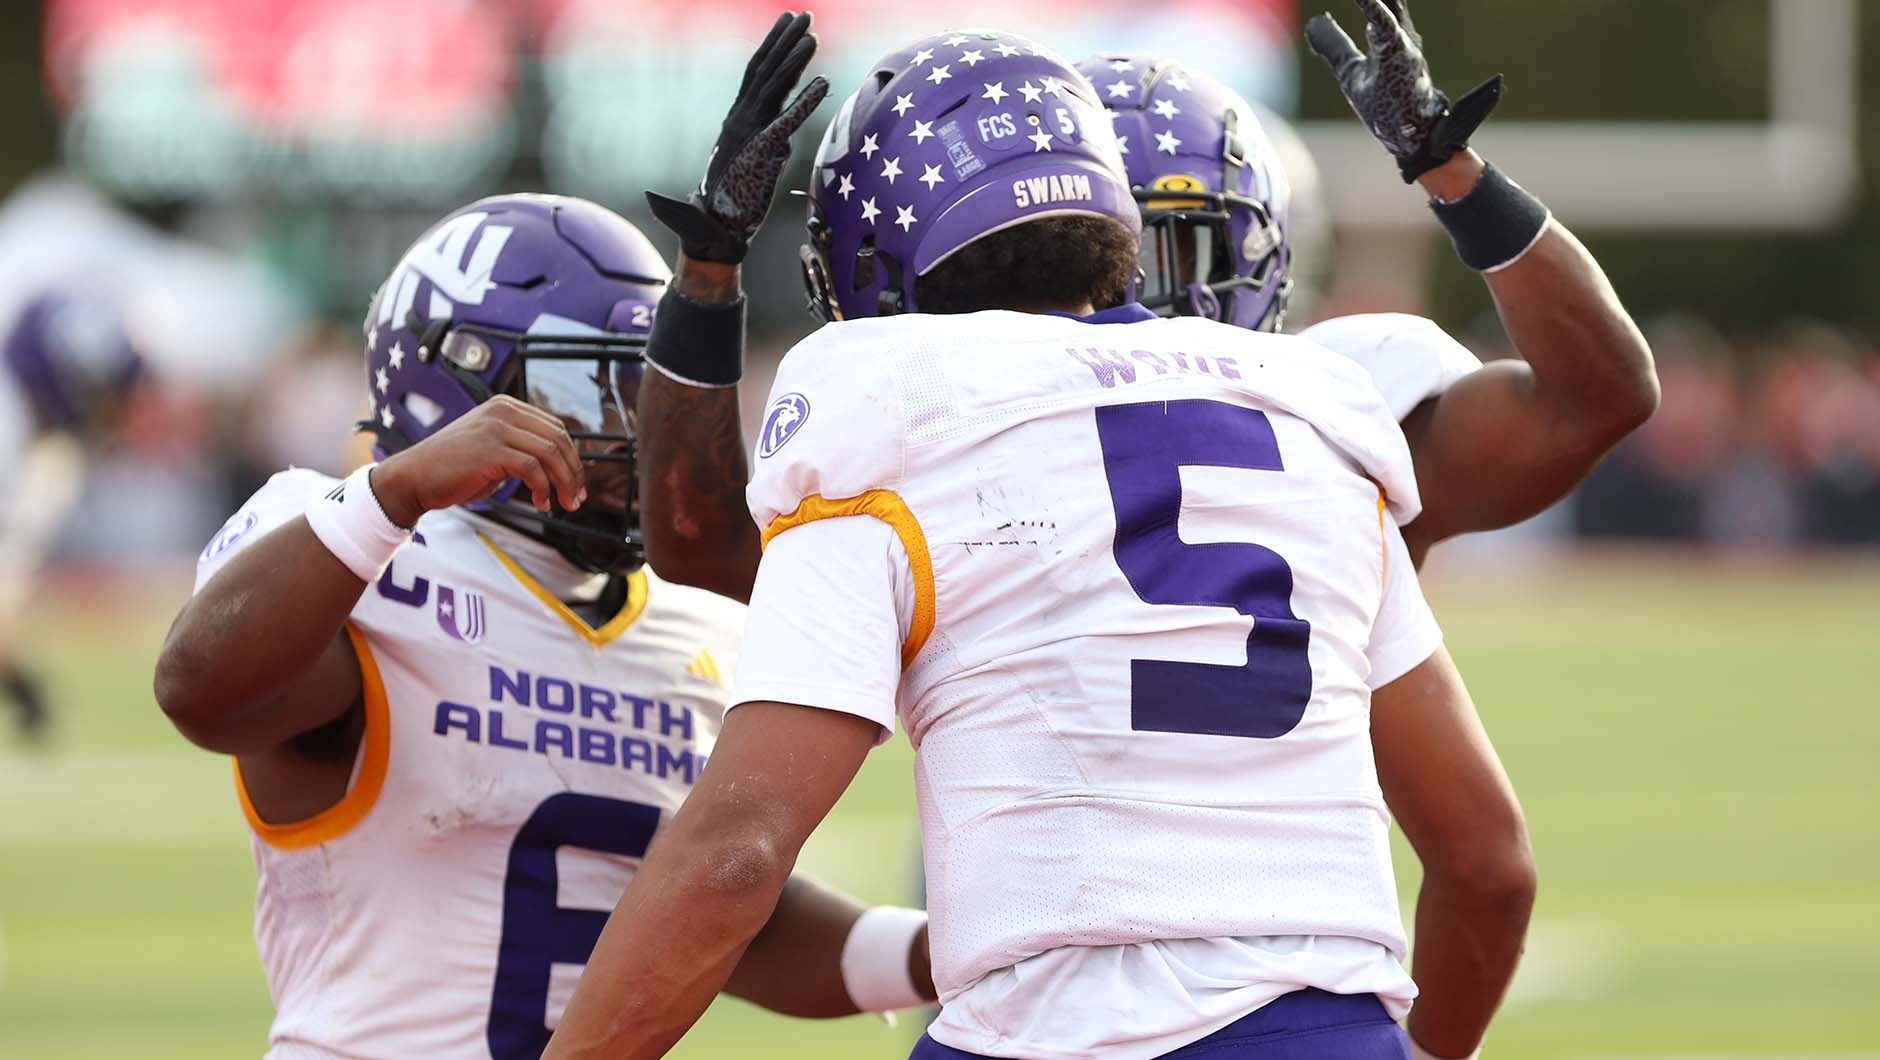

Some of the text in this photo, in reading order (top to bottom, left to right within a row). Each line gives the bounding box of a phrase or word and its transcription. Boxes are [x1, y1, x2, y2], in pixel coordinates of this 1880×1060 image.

[977, 112, 1017, 142] FCS
[1055, 108, 1076, 135] 5
[1012, 174, 1093, 209] SWARM
[631, 304, 657, 328] 2
[1094, 398, 1312, 739] 5
[489, 665, 694, 740] NORTH
[433, 701, 709, 784] ALABAM
